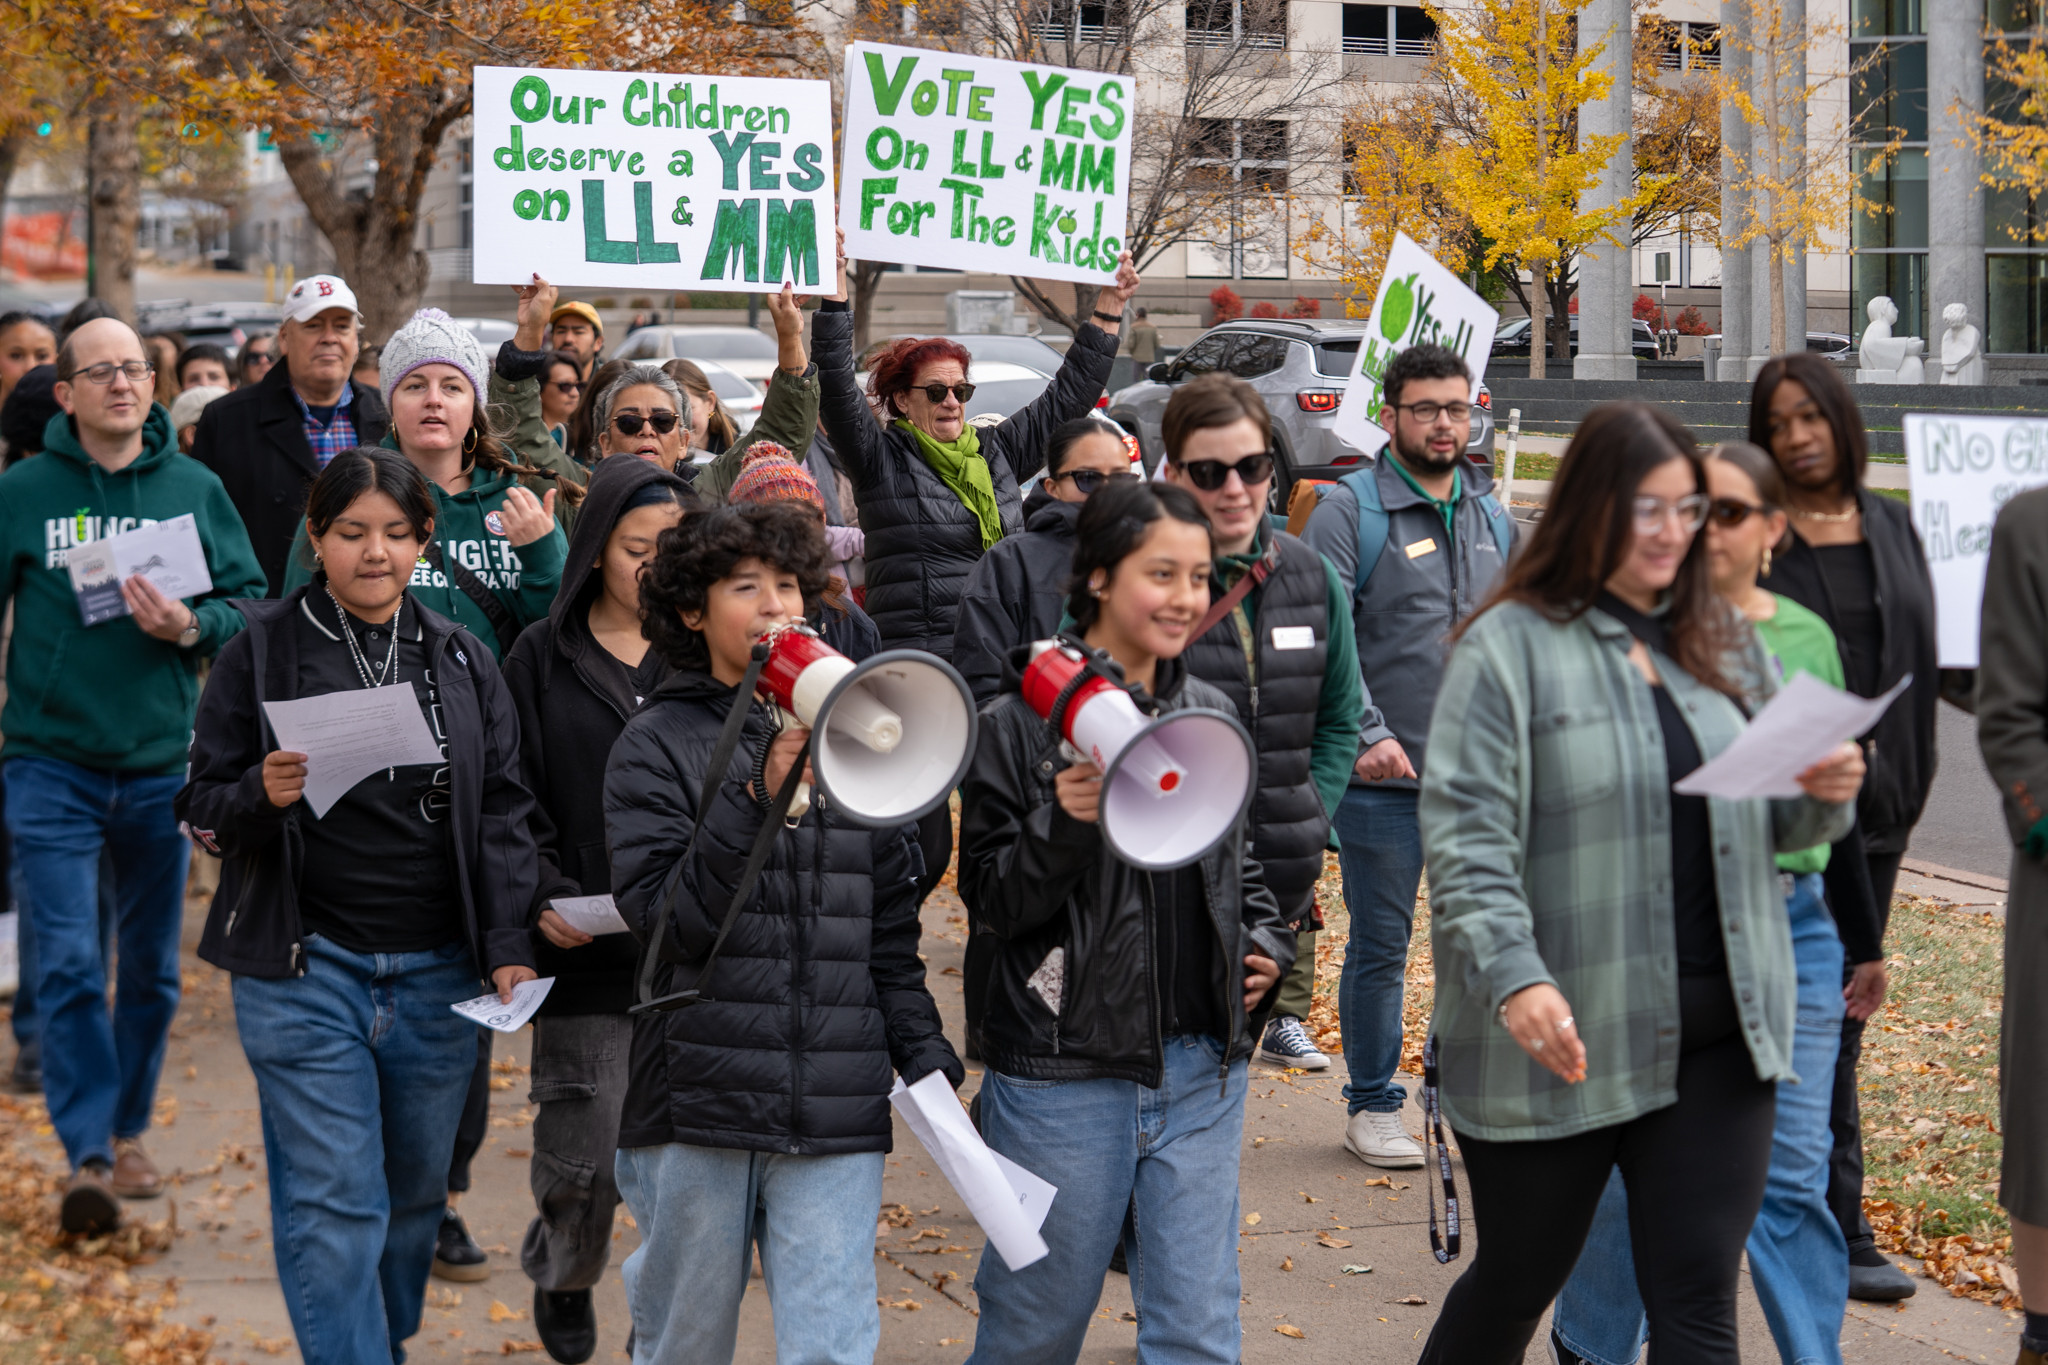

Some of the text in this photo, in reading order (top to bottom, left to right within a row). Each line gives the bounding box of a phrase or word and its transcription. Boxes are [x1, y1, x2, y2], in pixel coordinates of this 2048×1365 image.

[510, 75, 790, 134] Our Children
[1020, 70, 1125, 141] YES
[493, 125, 825, 192] deserve a YES
[865, 126, 1116, 195] On LL & MM
[513, 179, 820, 286] on LL & MM
[859, 176, 1121, 273] For The Kids
[316, 281, 333, 297] B
